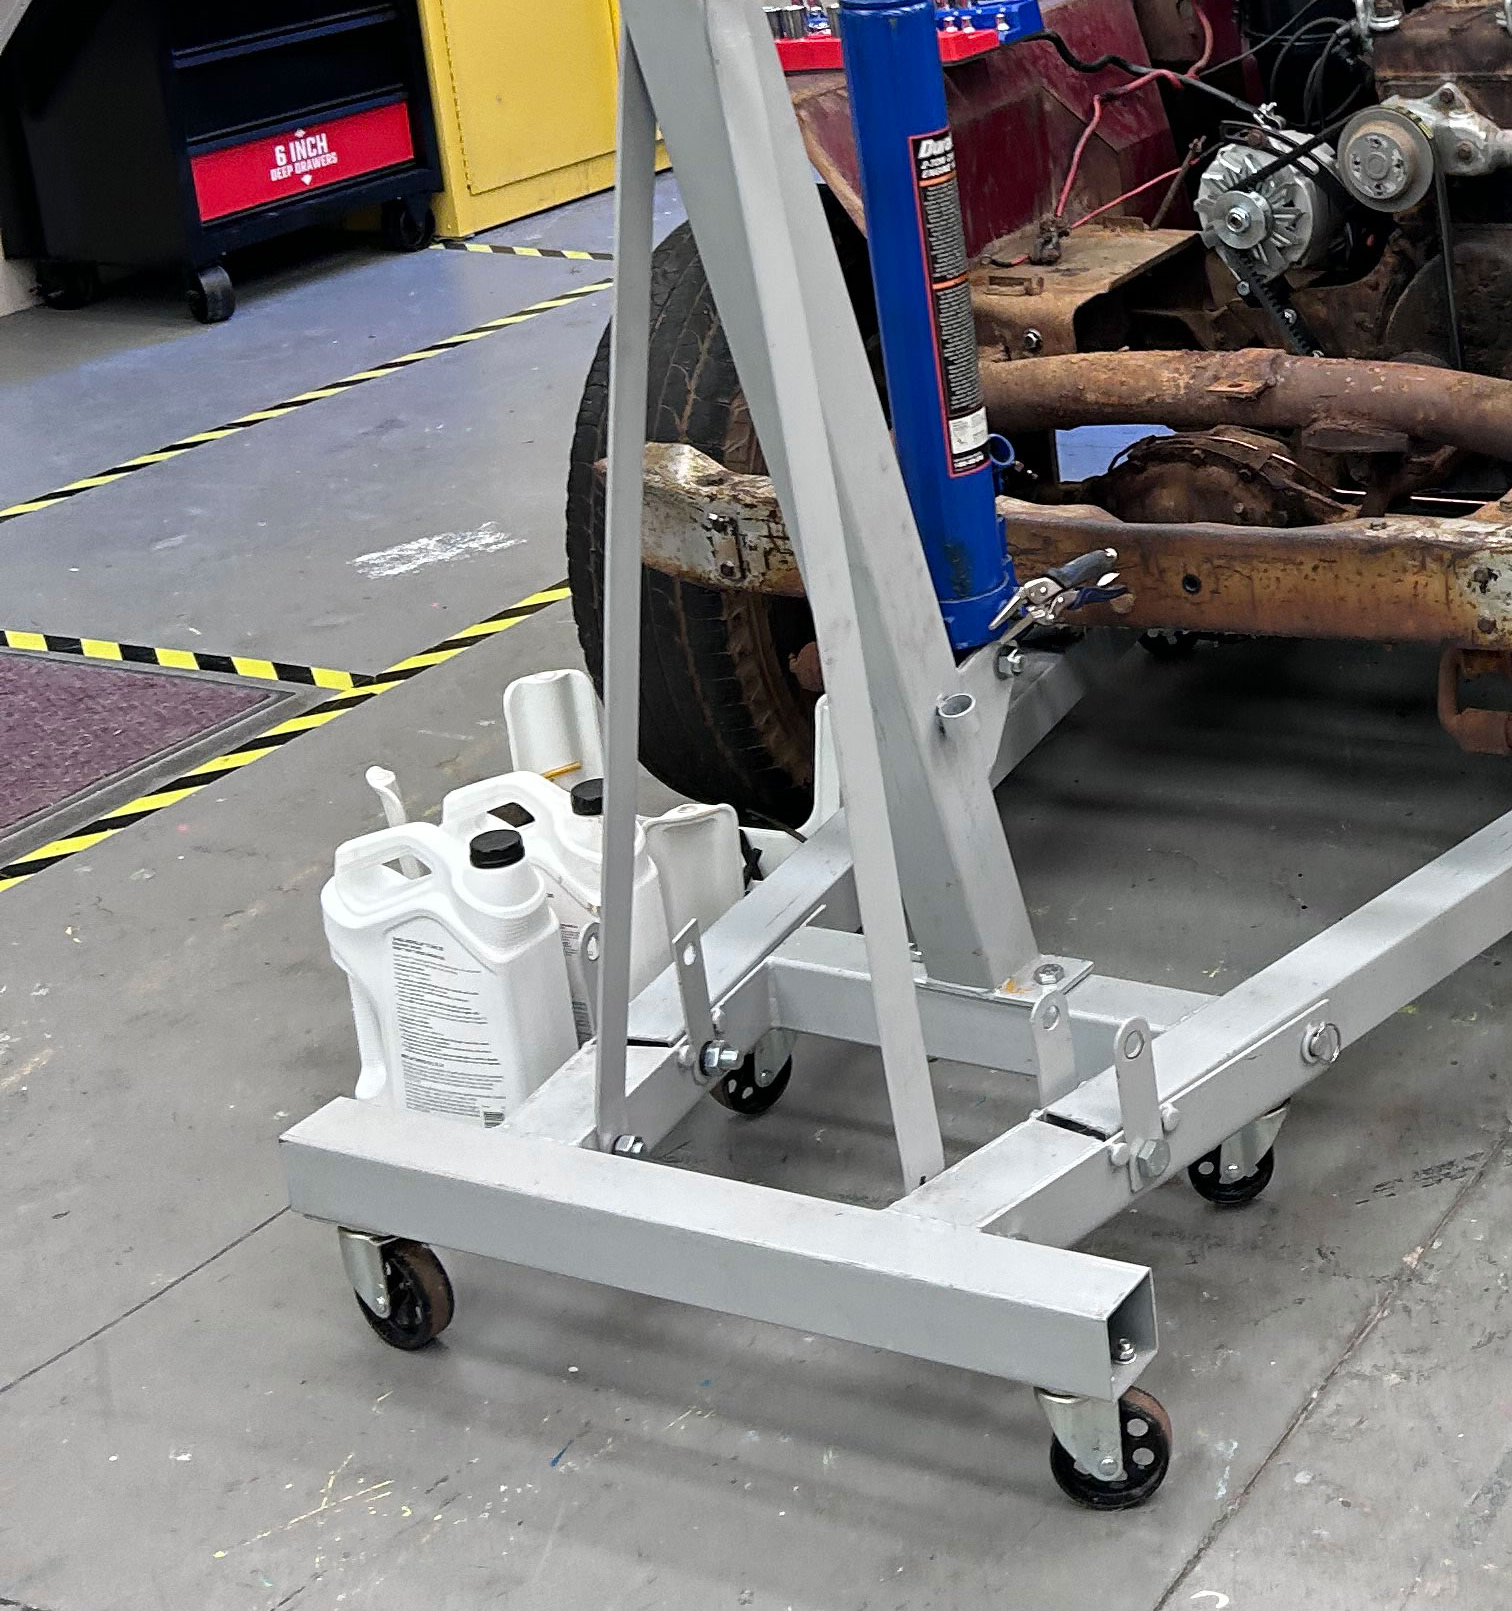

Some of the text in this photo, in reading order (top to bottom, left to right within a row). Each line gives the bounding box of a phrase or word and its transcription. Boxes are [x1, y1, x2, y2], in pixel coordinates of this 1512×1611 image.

[274, 133, 328, 166] 6 INCH
[270, 151, 338, 182] DEEP DRAWERS
